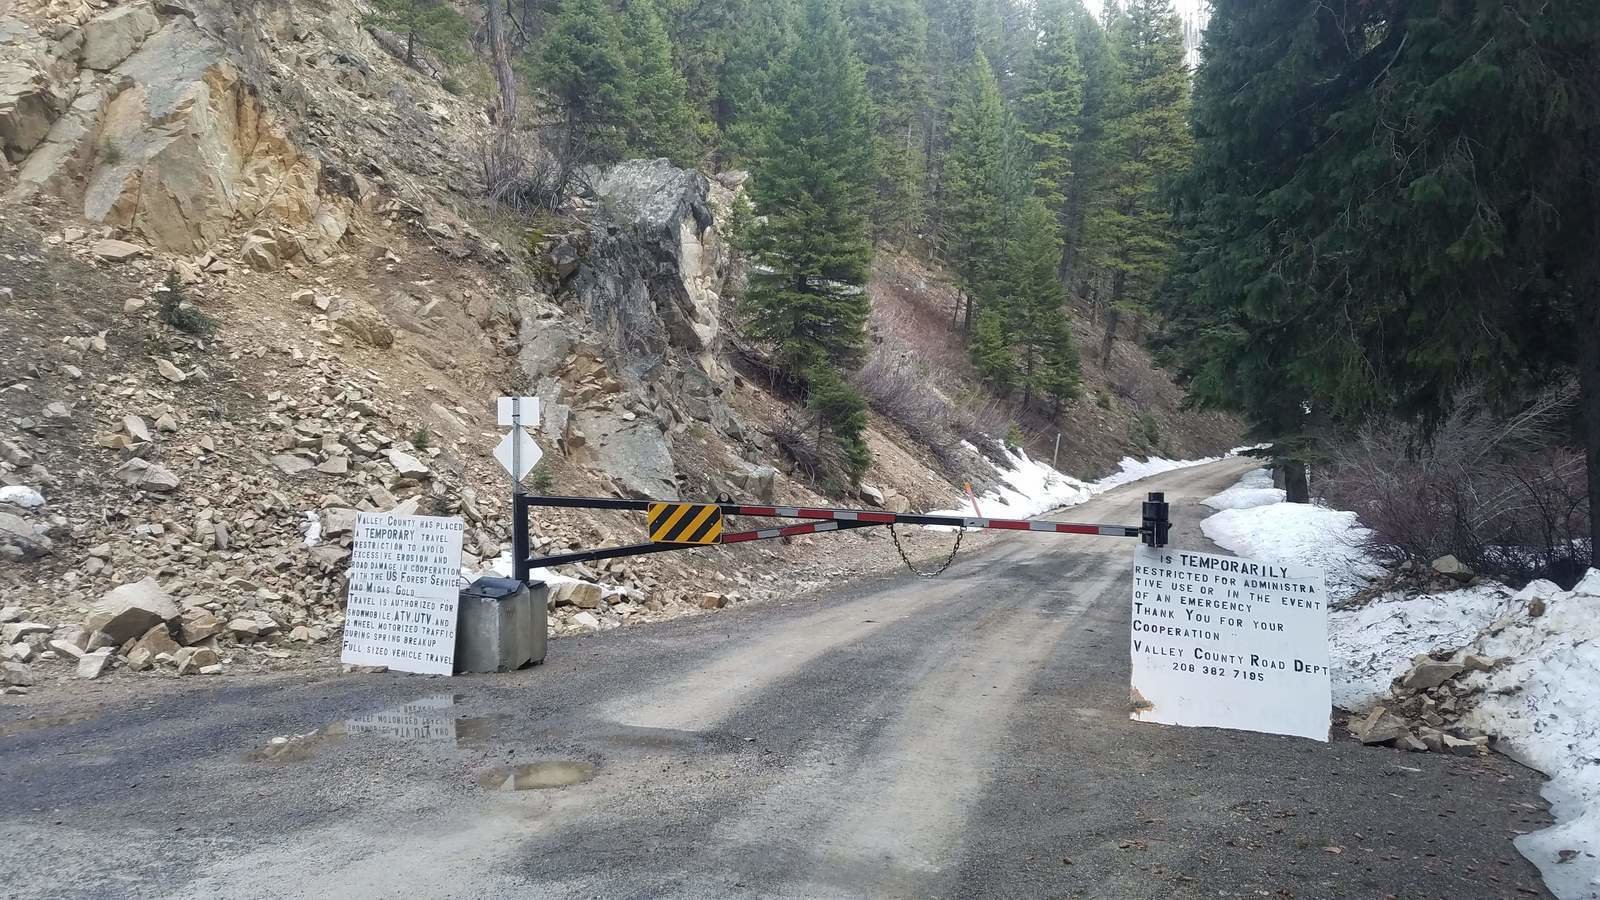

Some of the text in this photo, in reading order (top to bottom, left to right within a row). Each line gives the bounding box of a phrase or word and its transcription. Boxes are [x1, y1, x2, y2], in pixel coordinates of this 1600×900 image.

[357, 513, 382, 525] VALLEY
[388, 516, 415, 527] COUNTY
[436, 522, 462, 531] PLACED
[365, 528, 415, 540] TEMPORARY
[421, 534, 448, 542] TRAVEL
[354, 541, 402, 550] RESTRICTION
[422, 545, 444, 553] AVOID
[354, 551, 447, 564] EXCESSIVE EROSION AND
[1160, 554, 1288, 579] IS TEMPORARILY
[352, 561, 368, 569] ROAD
[370, 562, 396, 571] DAMAGE
[411, 565, 460, 575] COOPERATION
[1135, 565, 1209, 583] RESTRICTED
[1214, 575, 1237, 586] FOR
[351, 572, 367, 580] WITH
[387, 571, 397, 581] US
[401, 572, 427, 583] FOREST
[431, 575, 460, 587] SERVICE
[351, 582, 415, 596] AND MIDAS GOLD
[1136, 577, 1321, 611] TIVE USE OR IN THE EVENT
[350, 593, 375, 606] TRAVEL
[391, 600, 435, 610] AUTHORIZED
[440, 603, 453, 612] FOR
[1135, 590, 1252, 613] OF AN EMERGENCY
[435, 619, 449, 627] AND
[1135, 602, 1284, 632] THANK YOU FOR YOUR
[345, 629, 437, 647] DURING SPRING BREAKUP
[378, 623, 418, 633] MOTORIZED
[422, 627, 453, 638] TRAFFIC
[1133, 620, 1220, 641] COOPERATION
[343, 641, 452, 665] FULL SIZED VEHICLE TRAVEL
[1134, 640, 1328, 676] VALLEY COUNTY ROAD DEPT
[1172, 662, 1264, 681] 208 382 7195
